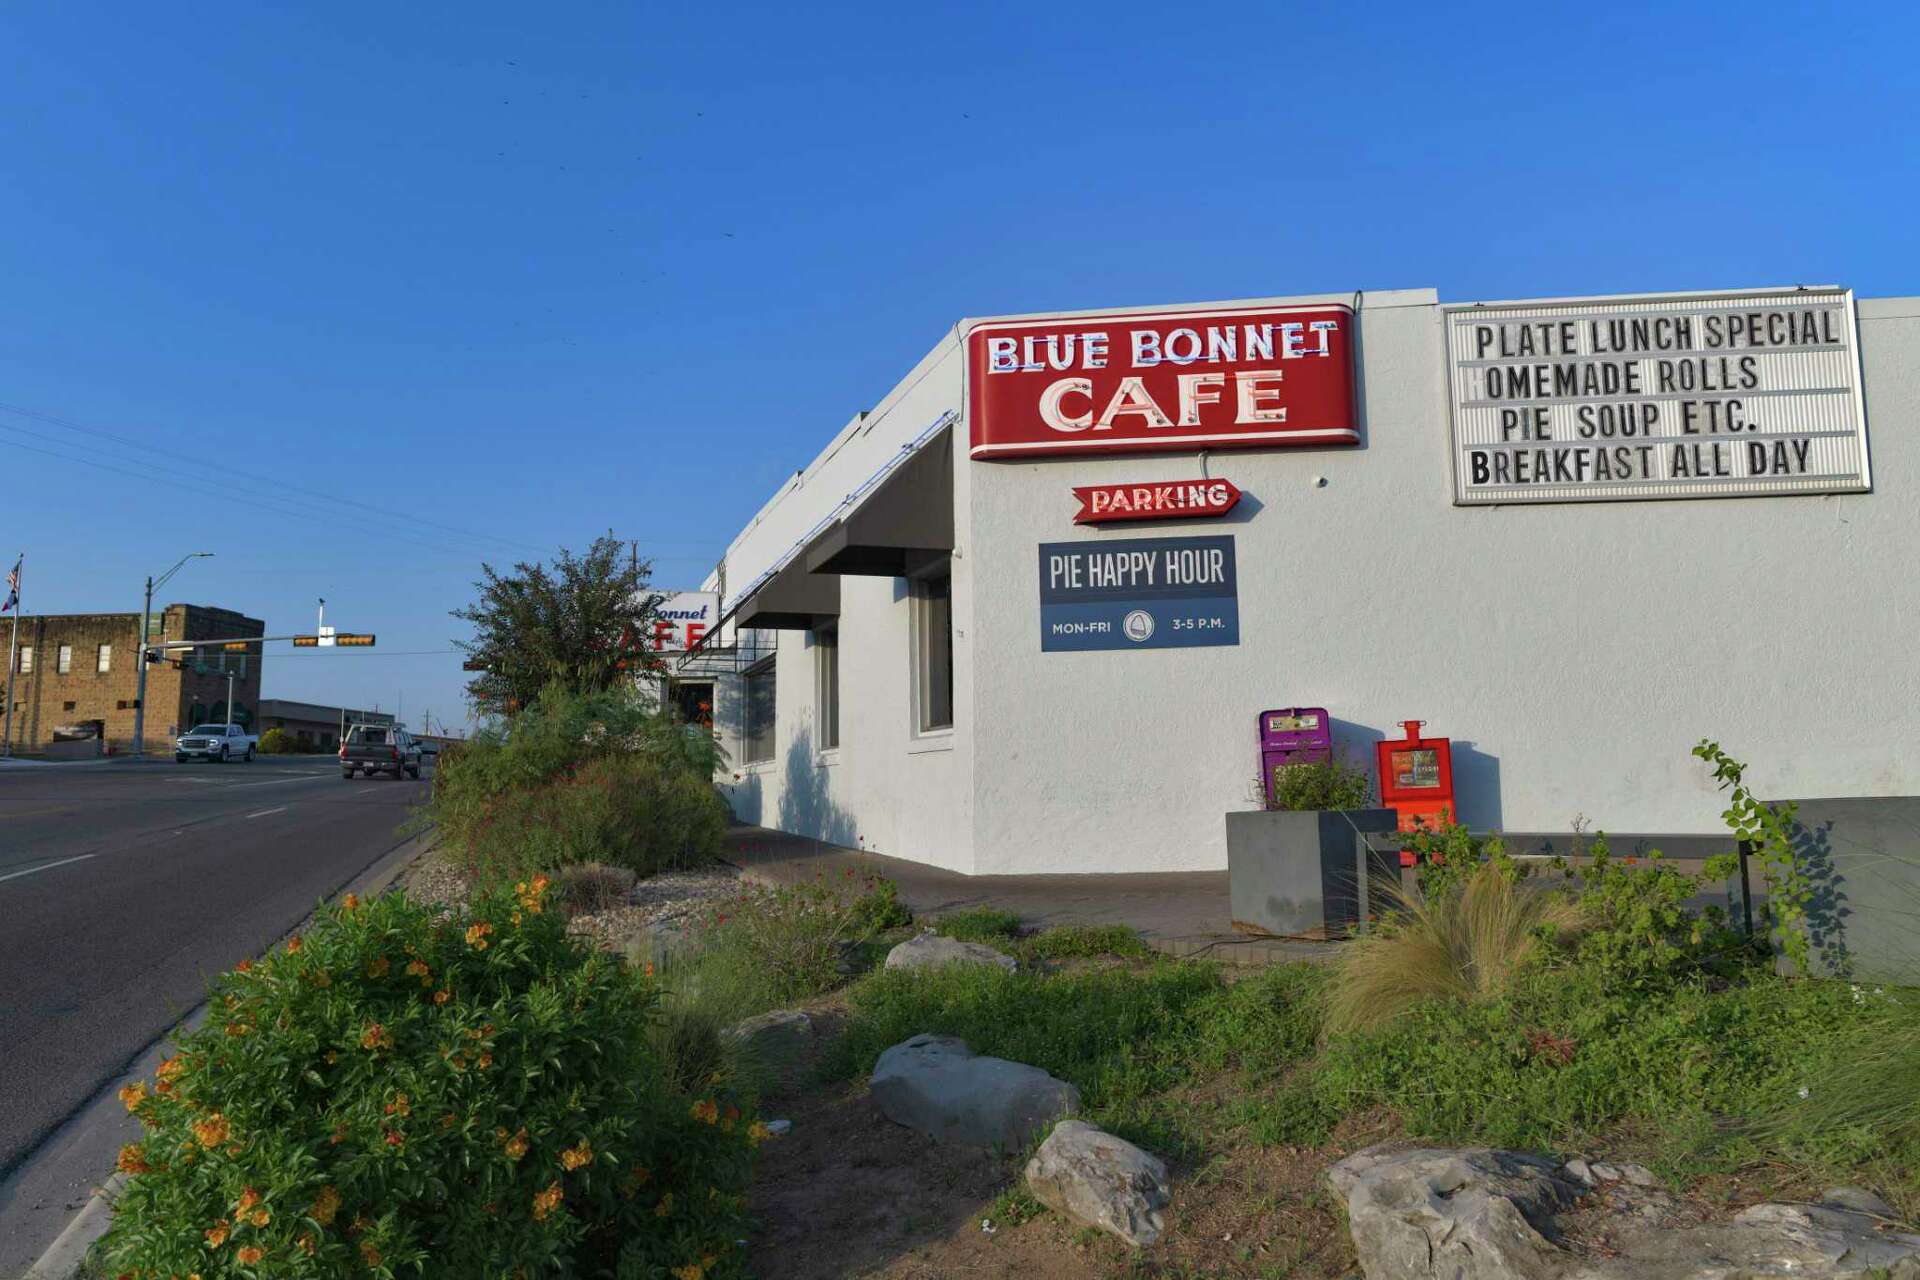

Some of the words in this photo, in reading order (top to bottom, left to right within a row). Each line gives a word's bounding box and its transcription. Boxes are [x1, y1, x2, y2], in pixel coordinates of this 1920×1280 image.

[988, 332, 1109, 375] BLUE
[1130, 321, 1339, 368] BONNET
[1476, 321, 1577, 359] PLATE
[1591, 317, 1694, 352] LUNCH
[1705, 310, 1840, 348] SPECIAL
[1658, 356, 1759, 392] ROLLS
[1038, 369, 1288, 433] CAFE
[1502, 407, 1552, 442] PIE
[1577, 403, 1660, 439] SOUP
[1682, 399, 1759, 434] ETC.
[1471, 446, 1655, 485] BREAKFAST
[1670, 442, 1731, 479] ALL
[1749, 438, 1812, 475] DAY
[1091, 483, 1229, 514] PARKING
[1050, 554, 1083, 590] PIE
[1088, 551, 1157, 587] HAPPY
[1166, 548, 1225, 585] HOUR
[1052, 621, 1111, 635] MON-FRI
[1172, 617, 1195, 630] 3-5
[1198, 616, 1226, 630] P.M.
